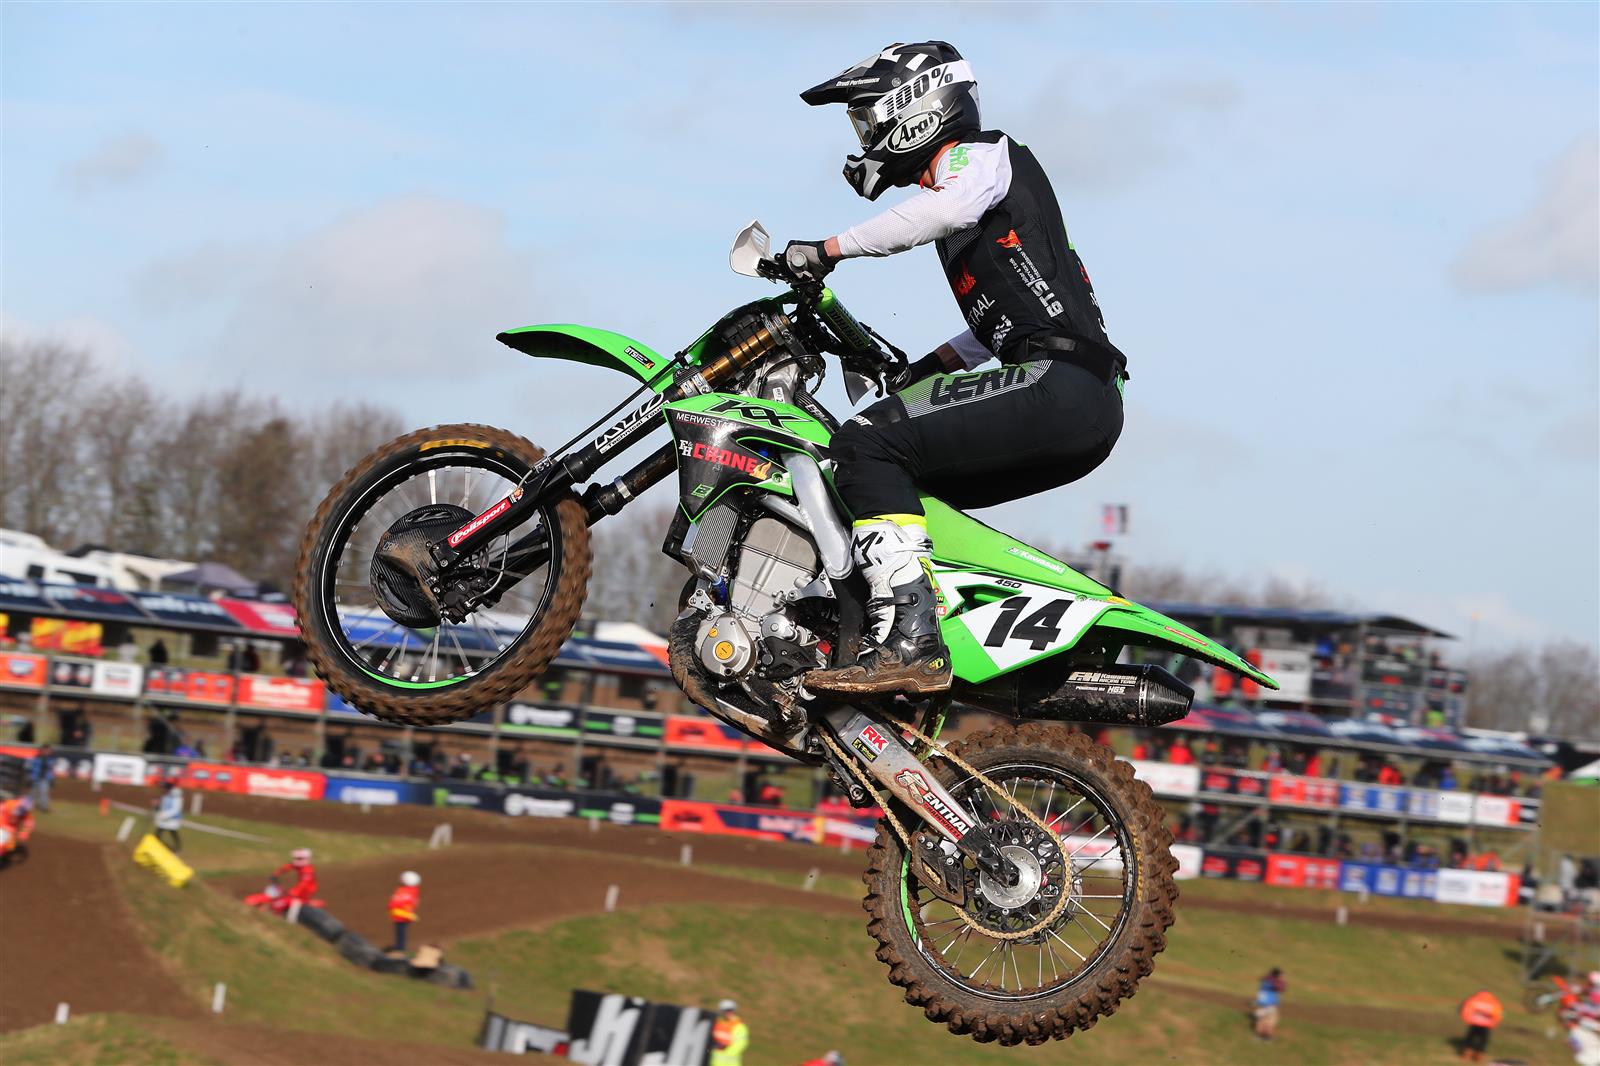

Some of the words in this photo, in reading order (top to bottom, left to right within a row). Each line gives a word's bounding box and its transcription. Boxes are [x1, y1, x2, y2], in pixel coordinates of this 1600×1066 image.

[882, 64, 954, 118] 100%
[895, 112, 934, 149] Arai
[703, 395, 815, 435] KX
[607, 420, 643, 447] Technical
[693, 442, 758, 475] CRONE
[451, 502, 506, 544] Polisport
[1019, 549, 1067, 575] Kawasaki
[995, 578, 1023, 589] 450
[983, 596, 1074, 652] 14
[1107, 686, 1126, 695] HGS
[862, 725, 889, 751] RK
